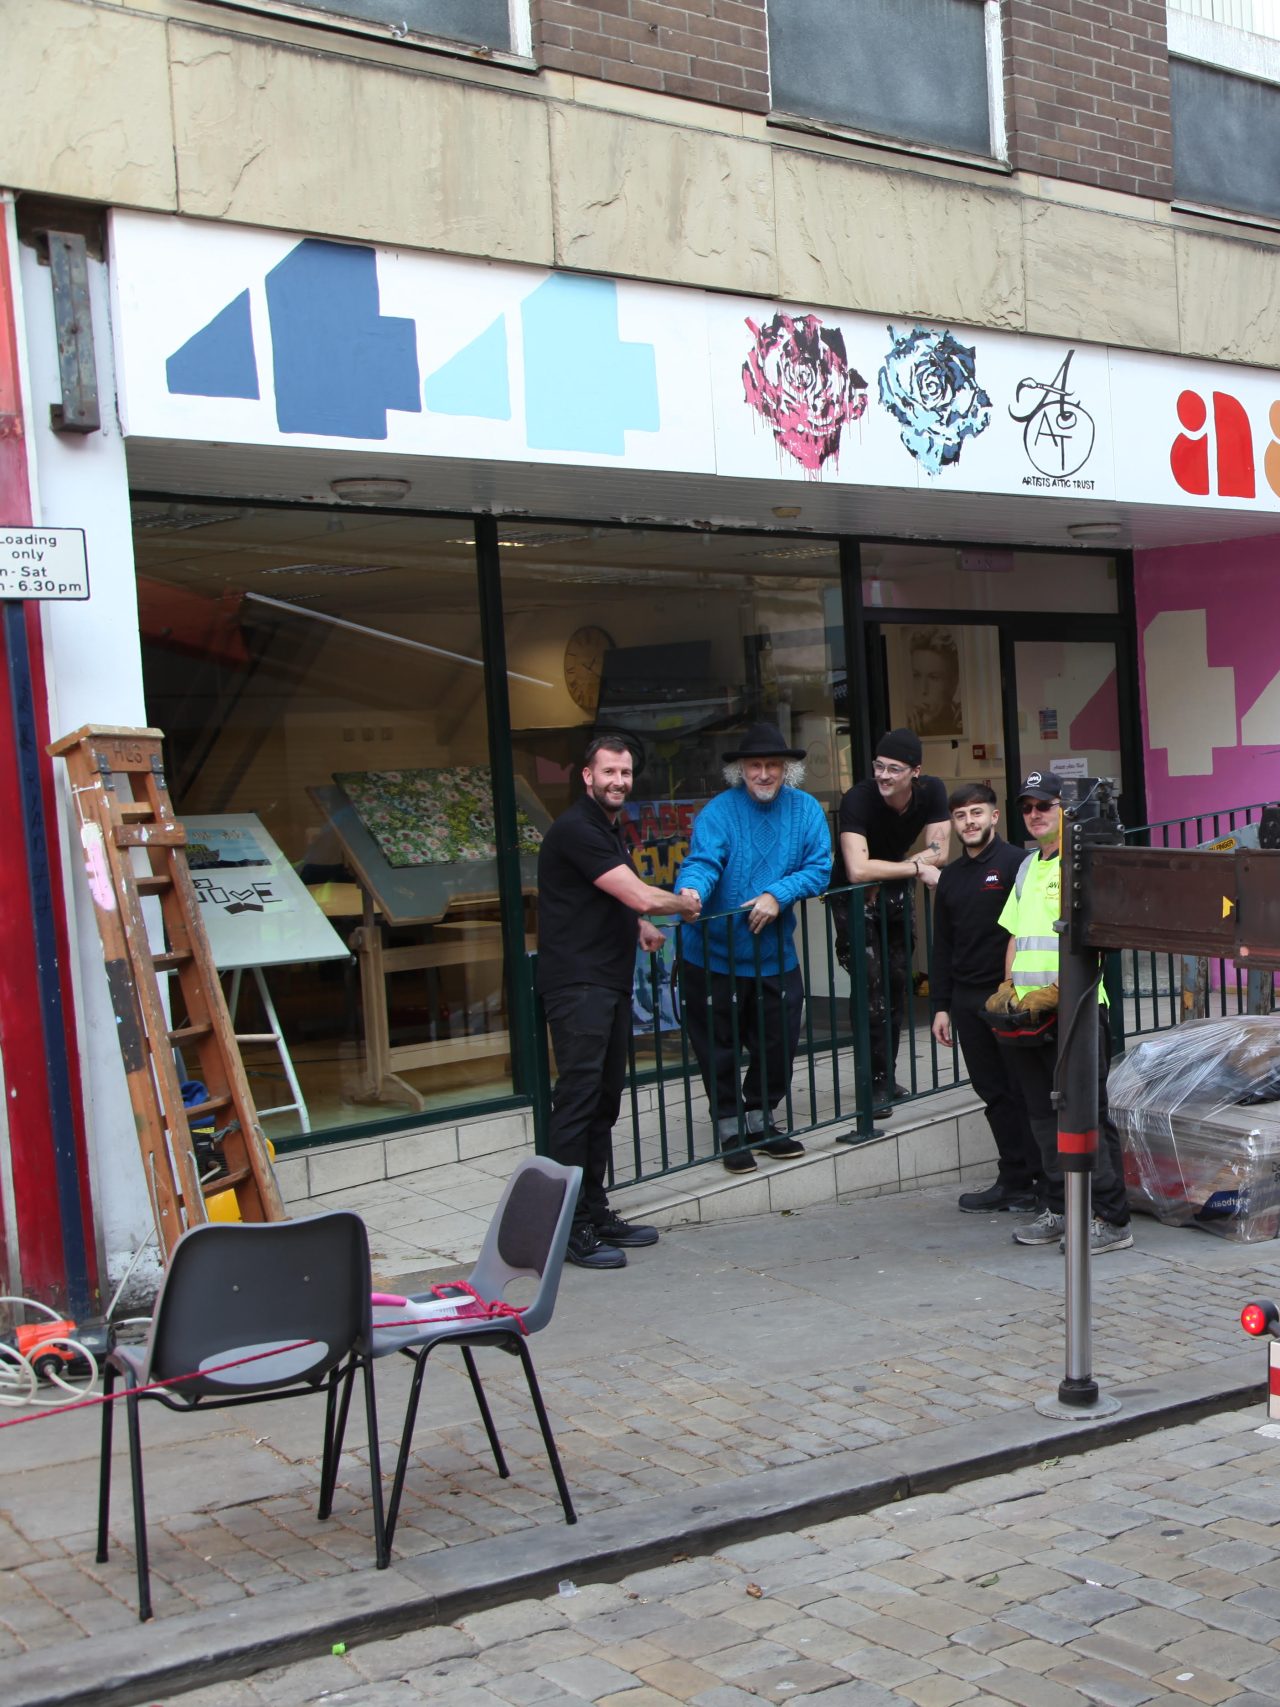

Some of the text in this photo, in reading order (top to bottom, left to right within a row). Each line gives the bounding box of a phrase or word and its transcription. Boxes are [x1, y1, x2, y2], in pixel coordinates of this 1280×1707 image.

[1022, 476, 1095, 490] ARTISTS ATTIC TRUST
[12, 549, 44, 561] only
[21, 566, 47, 577] Sat
